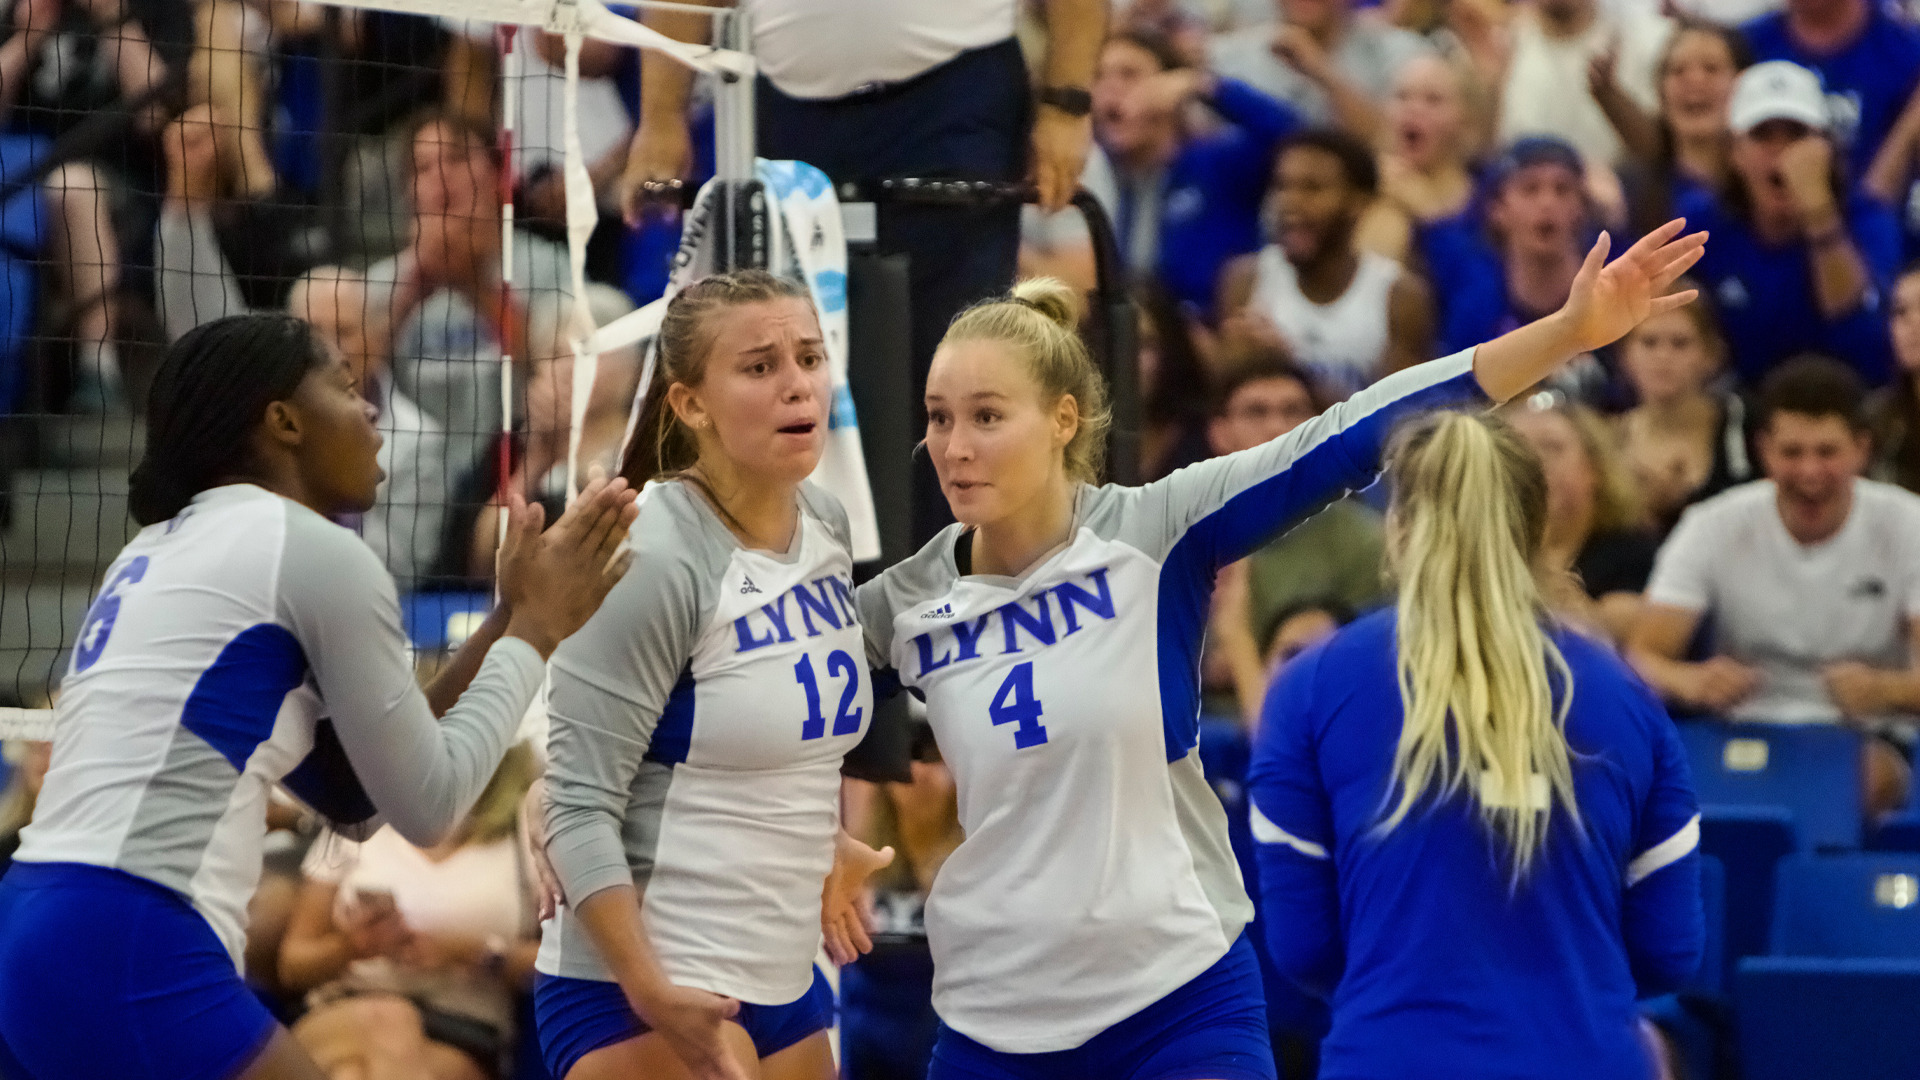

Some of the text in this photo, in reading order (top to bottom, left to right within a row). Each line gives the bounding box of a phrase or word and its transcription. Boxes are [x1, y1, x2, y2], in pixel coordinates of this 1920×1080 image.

[76, 555, 150, 673] 6
[733, 571, 856, 654] LYNN
[906, 566, 1116, 680] LYNN
[793, 649, 863, 741] 12
[988, 661, 1049, 750] 4
